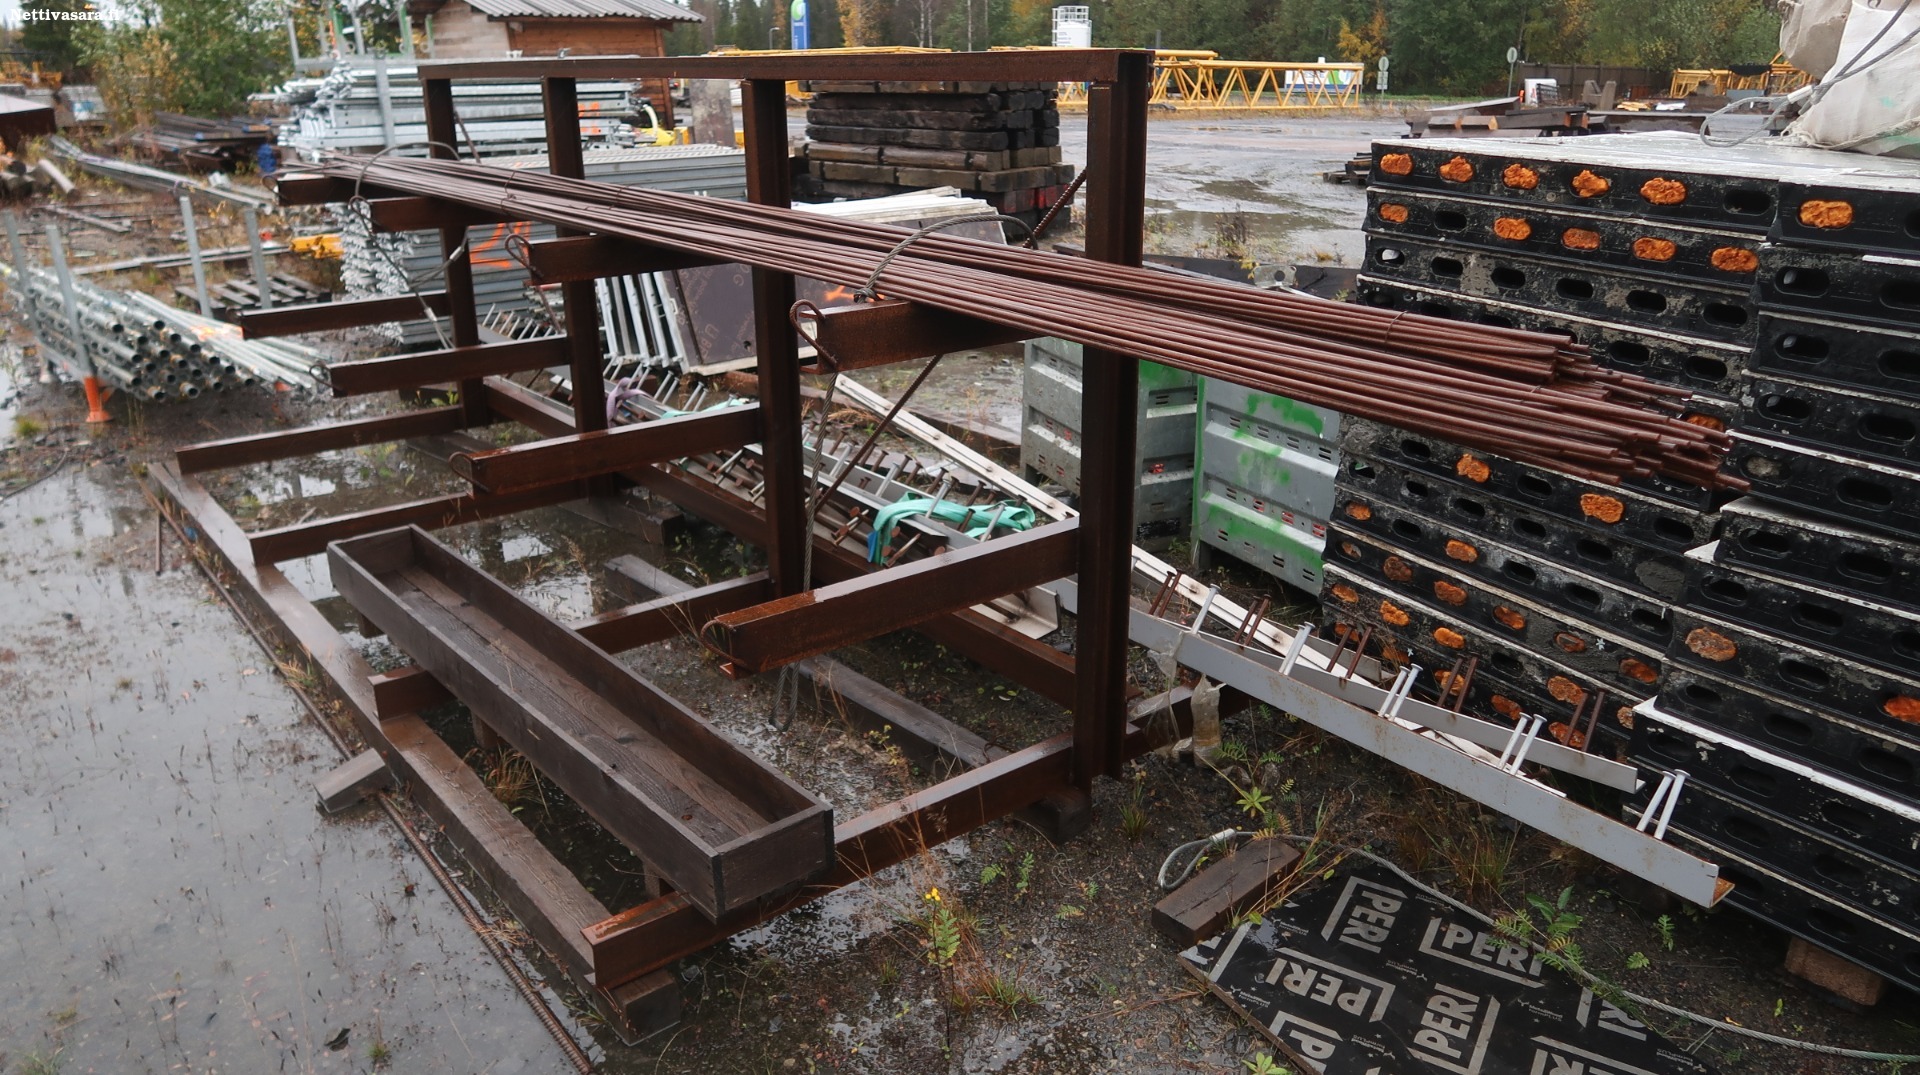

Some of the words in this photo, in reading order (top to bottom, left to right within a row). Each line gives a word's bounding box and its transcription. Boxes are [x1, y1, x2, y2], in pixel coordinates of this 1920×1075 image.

[1338, 890, 1403, 954] PERI
[1442, 923, 1546, 977] PERI
[1265, 958, 1372, 1017] PERI
[1413, 982, 1481, 1059] PERI
